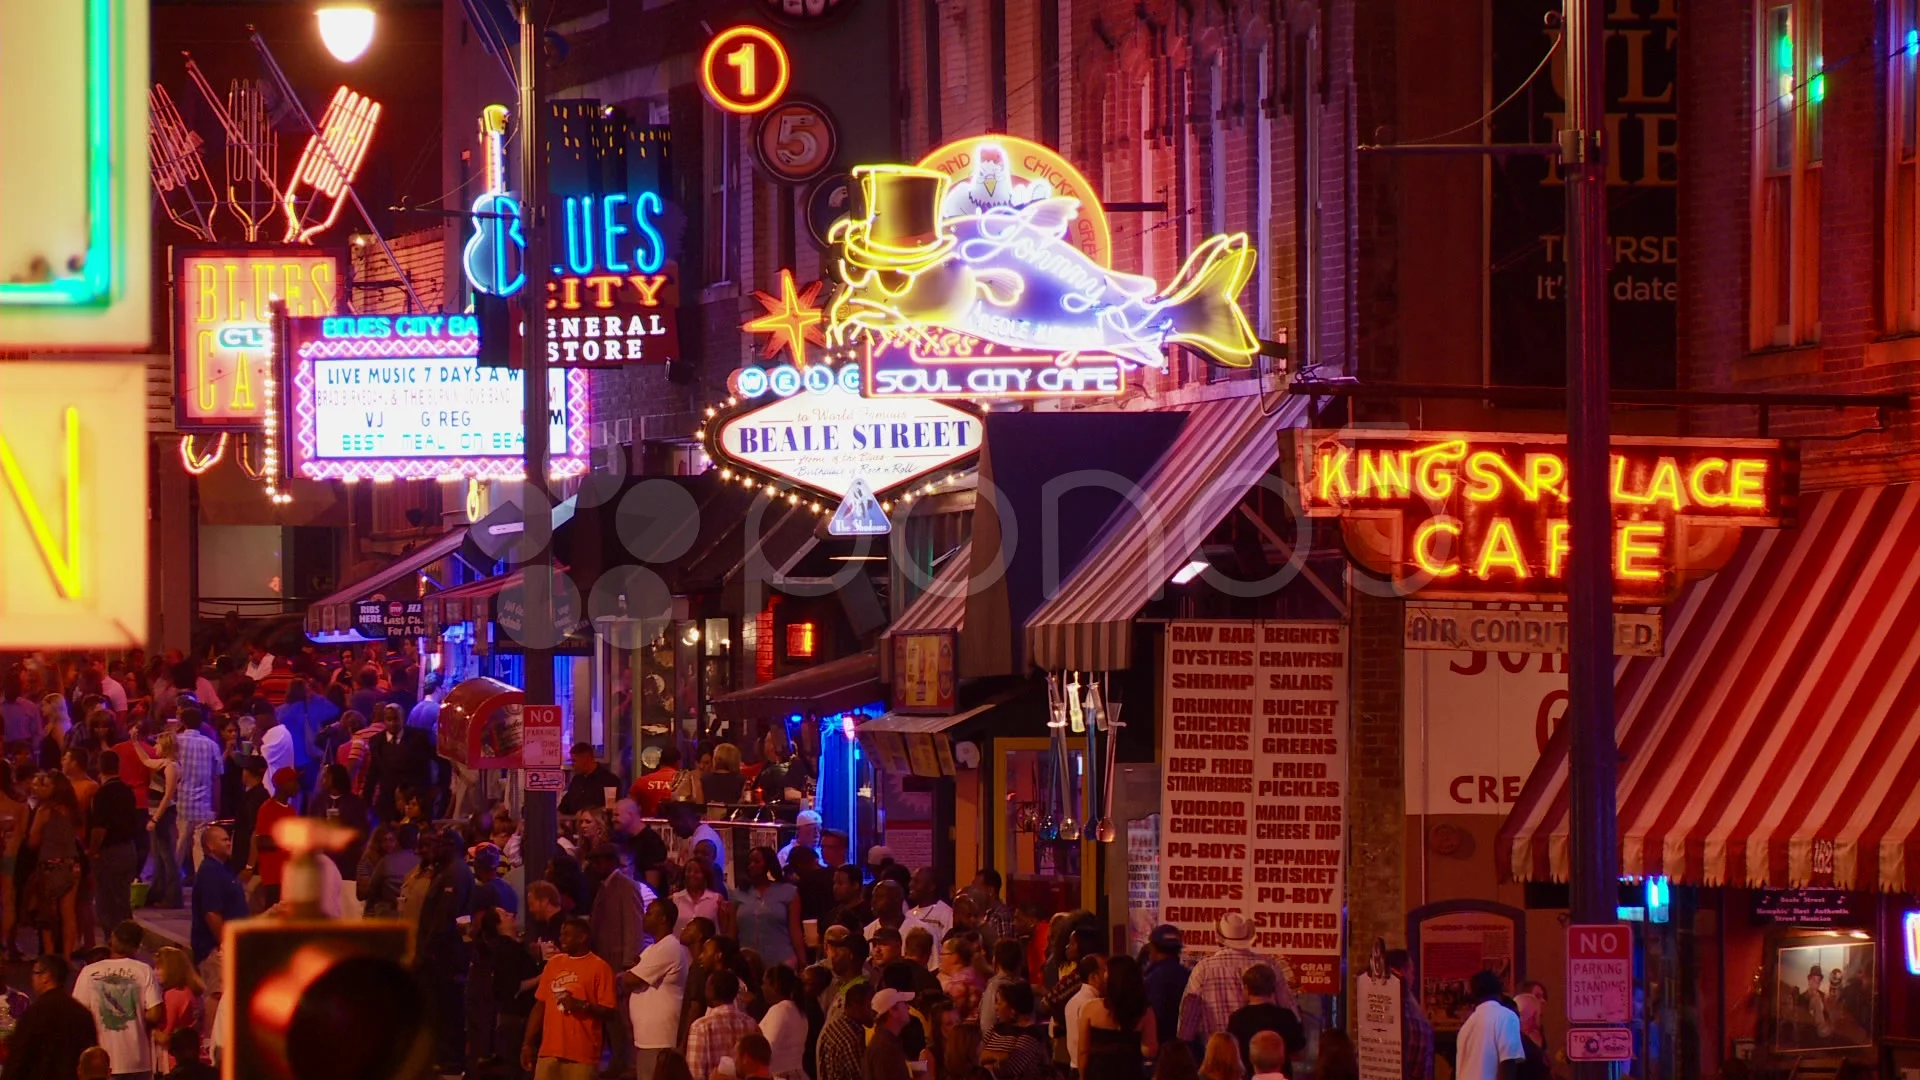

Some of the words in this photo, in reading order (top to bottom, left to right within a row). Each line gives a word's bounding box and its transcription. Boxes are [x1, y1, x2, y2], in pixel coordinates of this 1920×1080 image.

[727, 43, 756, 96] 1
[776, 115, 818, 166] 5
[496, 190, 666, 297] BUES
[1541, 235, 1677, 264] TRSD
[195, 263, 332, 323] BLUES
[546, 275, 668, 311] ITY
[322, 315, 391, 338] BLUES
[395, 315, 444, 338] CITY
[518, 313, 666, 339] ENERAL
[547, 339, 643, 363] STORE
[327, 367, 361, 385] LIVE
[367, 367, 416, 385] MUSIC
[423, 367, 433, 385] 7
[440, 366, 482, 383] DAYS
[488, 367, 500, 382] A
[876, 368, 962, 393] SOUL
[967, 368, 1033, 392] CITY
[1037, 366, 1119, 391] CAFE
[342, 433, 385, 451] BEST
[738, 424, 840, 453] BEALE
[852, 420, 971, 450] STREET
[1524, 452, 1768, 512] PLACE
[360, 605, 380, 614] RIBS
[359, 614, 382, 623] HERE
[383, 616, 405, 625] Last
[1172, 626, 1213, 642] RAW
[1218, 627, 1255, 643] BAR
[1264, 628, 1340, 644] BEIGNETS
[1411, 616, 1456, 643] AIR
[1471, 617, 1654, 646] CONDITED
[1172, 649, 1253, 666] OYSTERS
[1259, 651, 1343, 668] CRAWFISH
[1172, 673, 1254, 690] SHRIMP
[1270, 675, 1333, 690] SALADS
[1172, 698, 1253, 715] DRUNKIN
[1263, 699, 1339, 716] BUCKET
[530, 710, 554, 723] NO
[1173, 716, 1250, 733] CHICKEN
[526, 729, 558, 737] PARKING
[1268, 718, 1333, 734] HOUSE
[1174, 734, 1249, 750] NACHOS
[1262, 738, 1338, 755] GREENS
[1169, 757, 1206, 773] DEEP
[1211, 758, 1253, 774] FRIED
[1272, 762, 1327, 778] FRIED
[1167, 775, 1252, 793] STRAWBERRIES
[1259, 780, 1340, 797] PICKLES
[1171, 800, 1245, 817] VOODOO
[1255, 804, 1300, 821] MARDI
[1304, 805, 1342, 822] GRAS
[1170, 818, 1247, 835] CHICKEN
[1256, 824, 1310, 839] CHEESE
[1315, 824, 1341, 840] DIP
[1168, 842, 1246, 859] PO-BOYS
[1254, 849, 1341, 866] PEPPADEW
[1814, 839, 1833, 874] 162
[1169, 866, 1243, 882] CREOLE
[1254, 867, 1338, 884] BRISKET
[1168, 883, 1243, 900] WRAPS
[1258, 887, 1333, 904] PO-BOY
[1254, 912, 1337, 929] STUFFED
[1252, 932, 1338, 949] PEPPADEW
[1580, 933, 1618, 953] NO
[1300, 963, 1332, 971] GRAB
[1574, 963, 1623, 975] PARKING
[1300, 976, 1331, 984] BUDS
